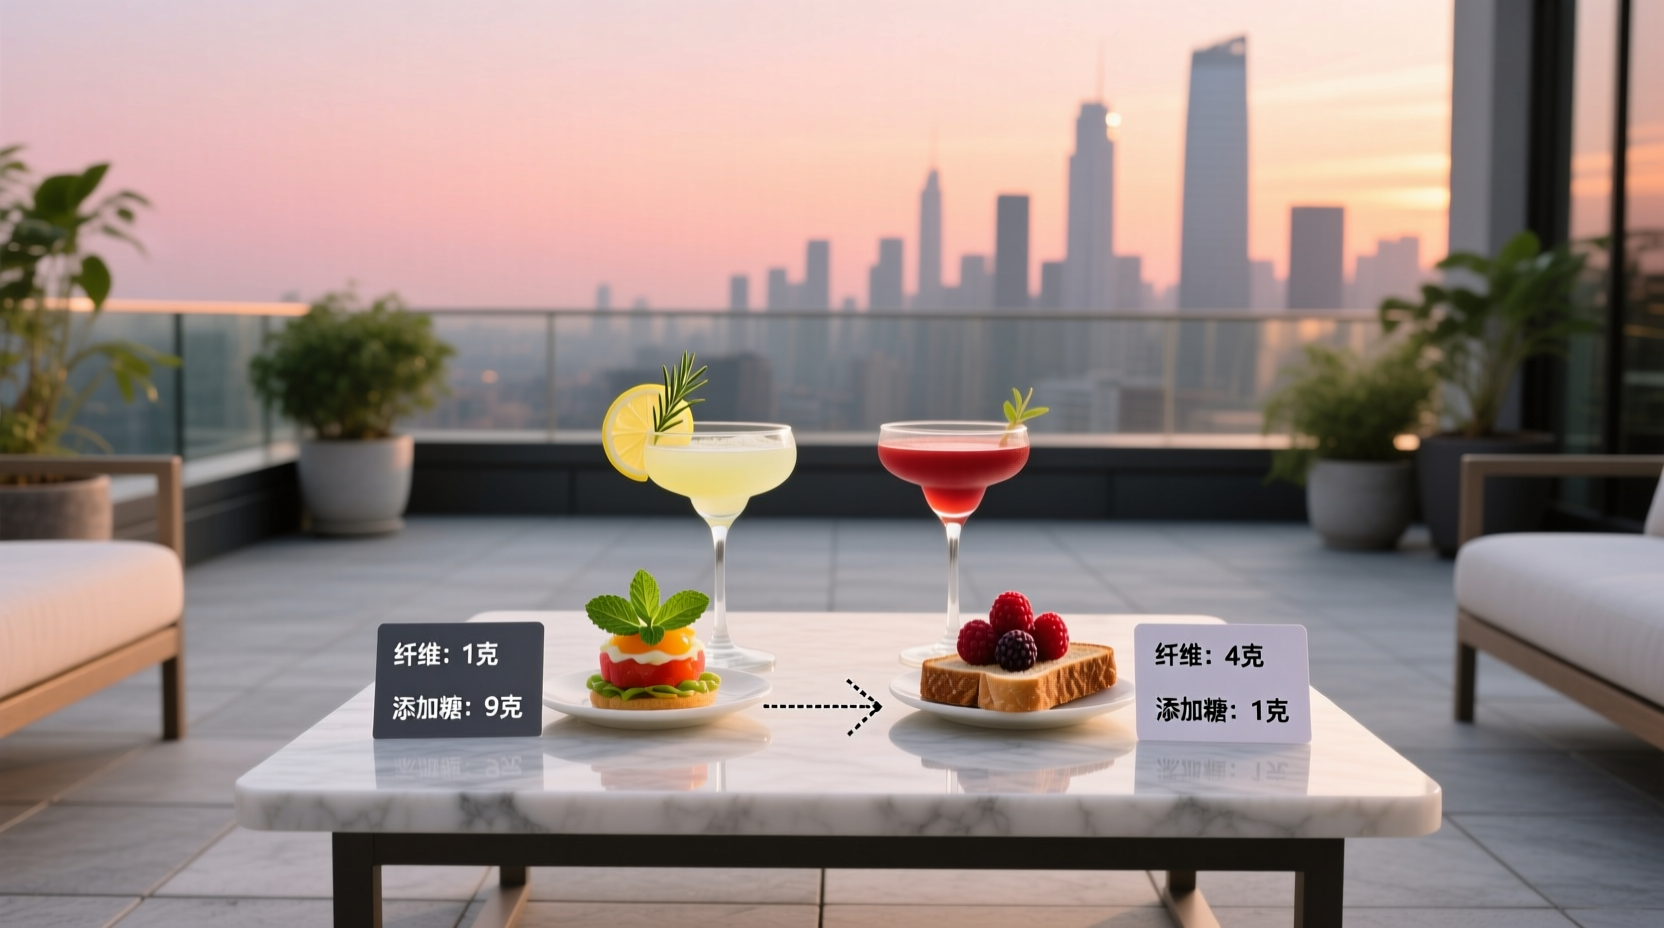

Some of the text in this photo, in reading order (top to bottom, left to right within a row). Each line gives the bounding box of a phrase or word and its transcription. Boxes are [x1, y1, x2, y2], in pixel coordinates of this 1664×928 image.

[393, 641, 499, 667] 纤维：1克
[1154, 642, 1265, 668] 纤维：4克
[392, 693, 523, 721] 添加糖：9克
[1155, 695, 1290, 724] 添加糖：1克
